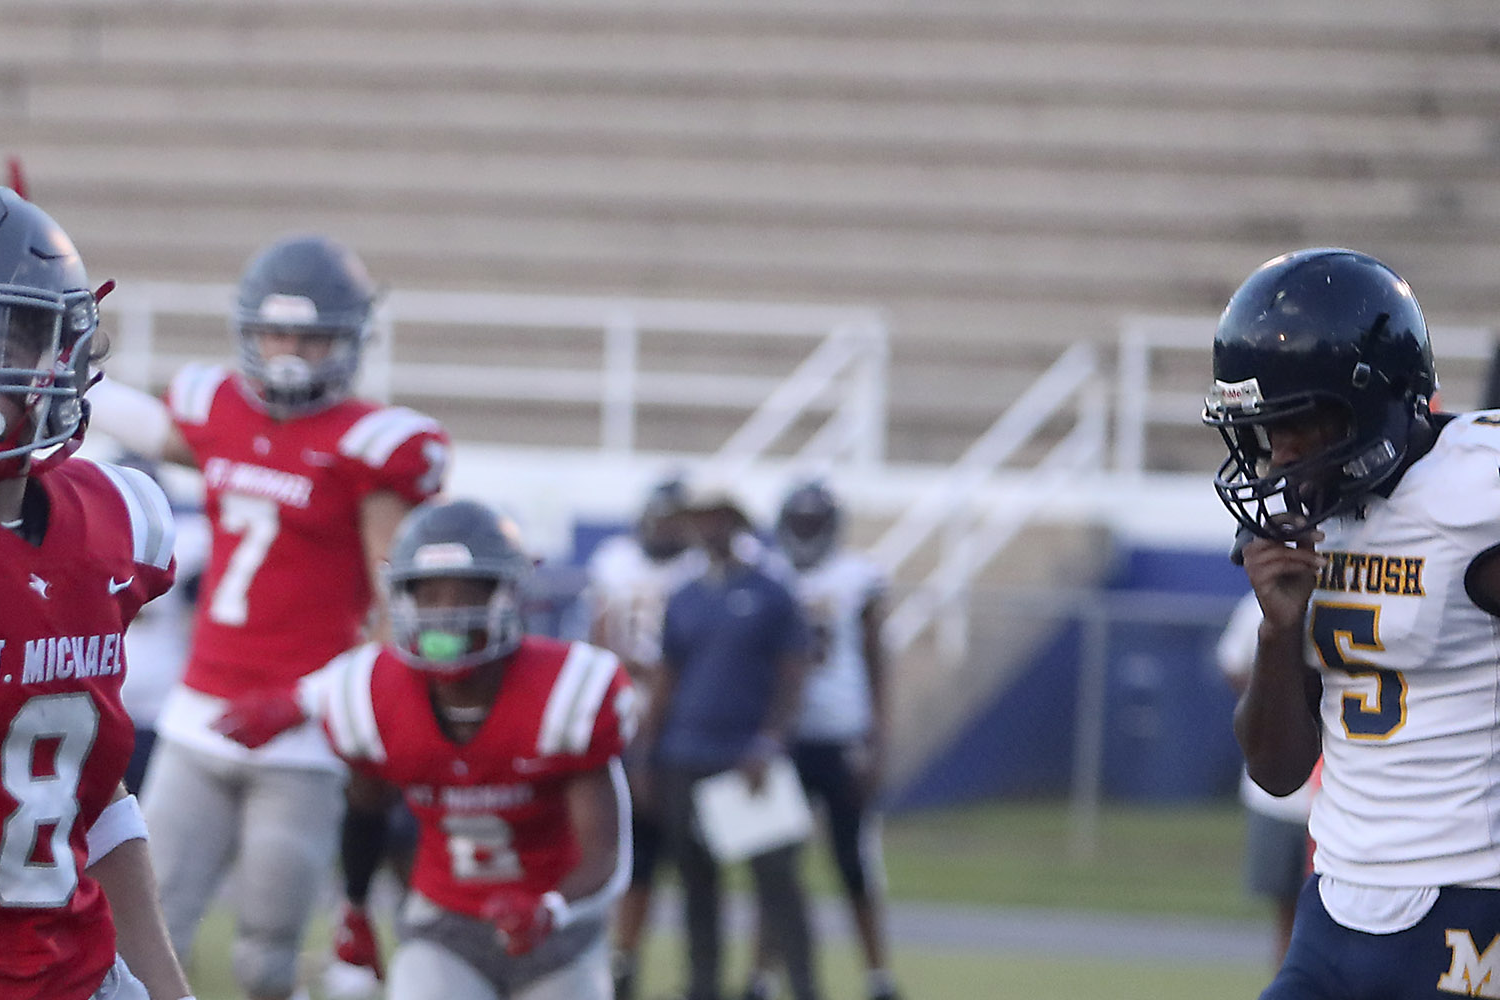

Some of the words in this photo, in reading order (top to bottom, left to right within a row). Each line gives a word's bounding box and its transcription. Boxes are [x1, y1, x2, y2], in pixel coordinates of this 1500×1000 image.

[208, 493, 281, 627] 7
[21, 633, 122, 684] MICHAEL
[1309, 600, 1409, 741] 5
[1436, 927, 1500, 1000] M
